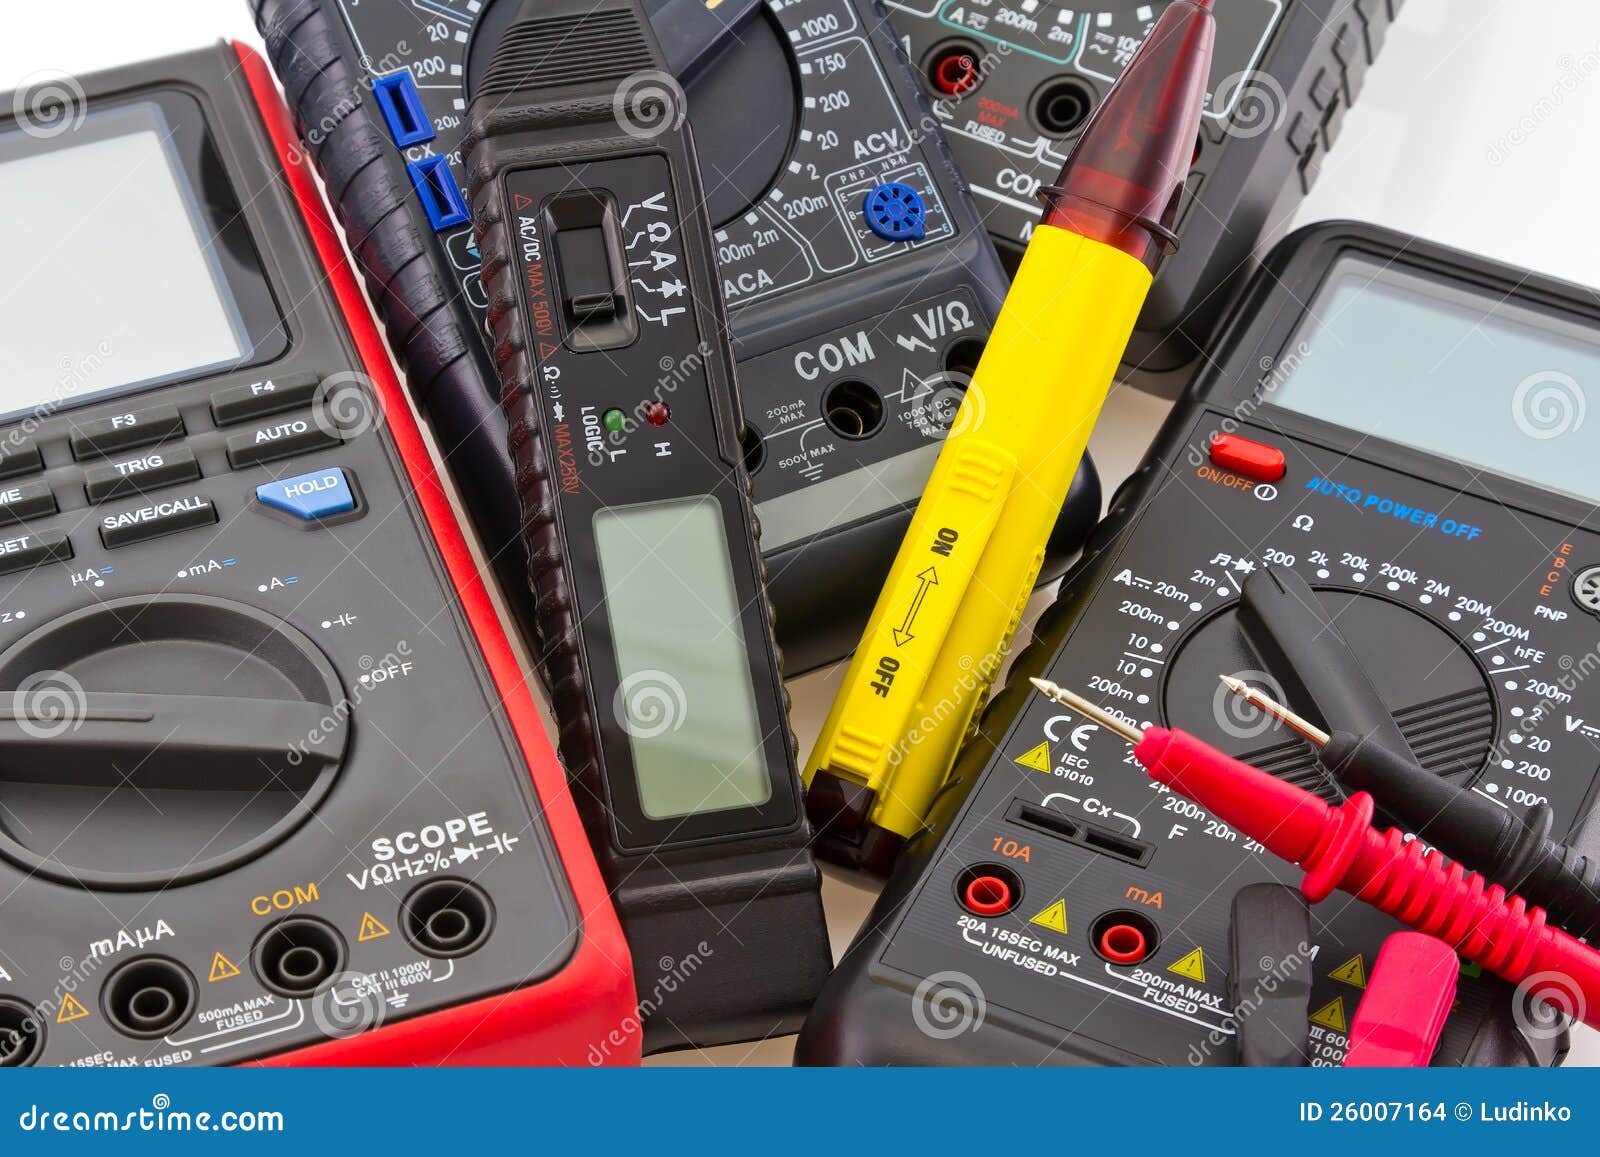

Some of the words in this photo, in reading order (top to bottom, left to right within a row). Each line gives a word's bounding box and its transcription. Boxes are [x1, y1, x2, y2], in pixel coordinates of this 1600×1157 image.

[802, 14, 838, 37] 1000
[995, 8, 1038, 33] 200m
[427, 22, 449, 42] 20
[1048, 26, 1073, 45] 2m
[414, 56, 445, 78] 200
[815, 53, 846, 75] 750
[819, 90, 850, 112] 200
[817, 130, 839, 151] 20
[965, 120, 1006, 143] FUSED
[853, 129, 901, 159] ACV
[807, 163, 820, 181] 2
[783, 194, 828, 220] 200m
[518, 216, 541, 262] AC/DC
[753, 229, 779, 248] 2m
[527, 263, 546, 298] MAX
[724, 269, 774, 299] ACA
[794, 331, 876, 380] COM
[250, 380, 275, 395] F4
[766, 400, 806, 418] 200mA
[779, 411, 805, 425] MAX
[111, 414, 137, 429] F3
[255, 421, 307, 443] AUTO
[581, 406, 604, 452] LOGIC
[115, 455, 164, 476] TRIG
[778, 452, 810, 469] 500V
[810, 444, 836, 457] MAX
[284, 475, 338, 498] HOLD
[1196, 465, 1253, 492] ON/OFF
[103, 496, 208, 529] SAVE/CALL
[1305, 476, 1361, 505] AUTO
[1363, 494, 1438, 529] POWER
[1440, 519, 1483, 542] OFF
[930, 527, 959, 557] ON
[1263, 548, 1296, 567] 200
[1307, 550, 1329, 566] 2k
[1340, 552, 1370, 571] 20k
[1190, 569, 1216, 587] 2m
[1379, 562, 1419, 586] 200k
[1153, 581, 1189, 603] 20m
[1424, 579, 1451, 598] 2M
[1118, 600, 1164, 625] 200m
[1454, 597, 1493, 618] 20M
[1534, 605, 1568, 623] PNP
[1483, 617, 1530, 641] 200M
[1128, 632, 1148, 649] 10
[1514, 645, 1546, 664] hFE
[371, 662, 412, 682] OFF
[870, 656, 900, 698] OFF
[1116, 659, 1136, 675] 10
[1087, 675, 1134, 701] 200m
[1525, 679, 1572, 704] 200m
[1529, 708, 1543, 721] 2
[1527, 735, 1551, 753] 20
[1060, 752, 1090, 770] IEC
[1516, 761, 1551, 781] 200
[1054, 766, 1094, 786] 61010
[1163, 796, 1206, 821] 200n
[371, 811, 493, 862] SCOPE
[1168, 824, 1188, 840] F
[1203, 820, 1237, 842] 20n
[992, 836, 1031, 863] 10A
[251, 882, 320, 916] COM
[1125, 885, 1164, 909] mA
[957, 915, 986, 934] 20A
[992, 927, 1043, 953] 15SEC
[1043, 945, 1080, 967] MAX
[983, 942, 1058, 977] UNFUSED
[198, 1005, 243, 1023] 500mA
[243, 994, 274, 1011] MAX
[1144, 987, 1199, 1015] FUSED
[1185, 987, 1223, 1008] MAX
[216, 1009, 264, 1030] FUSED
